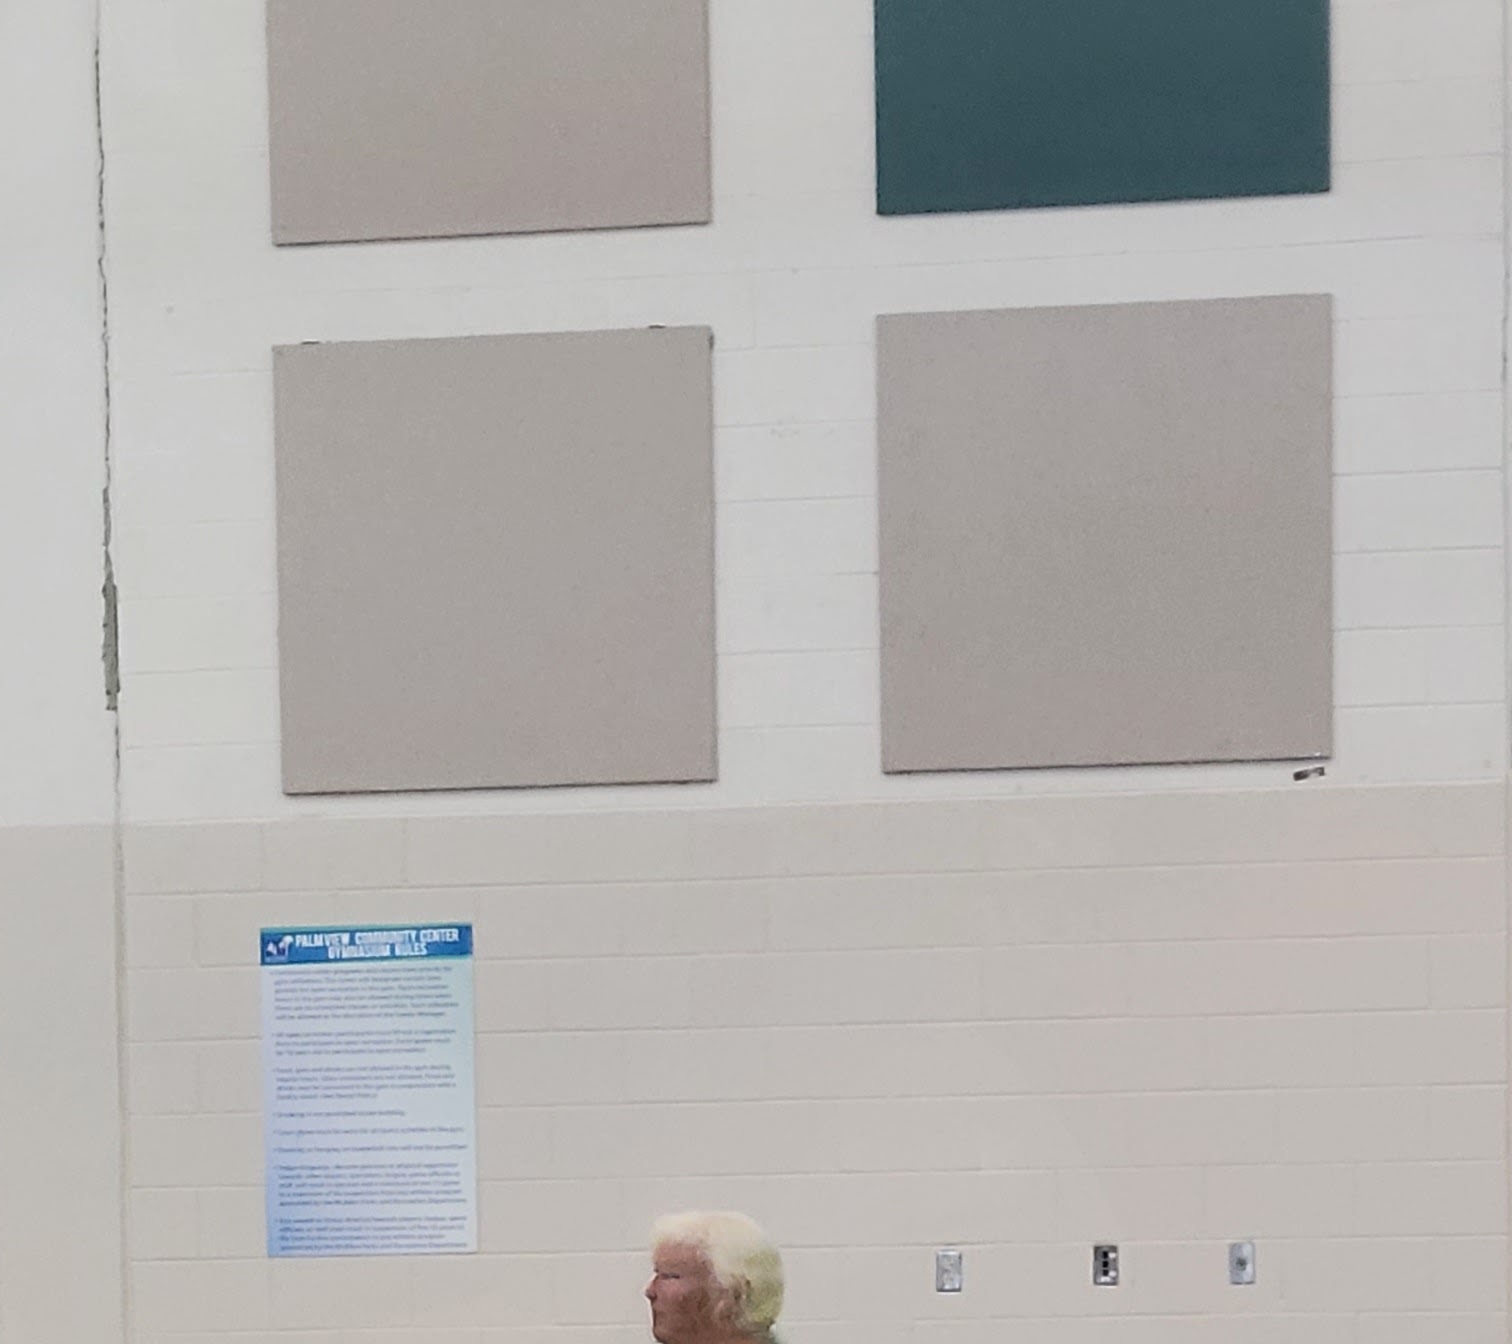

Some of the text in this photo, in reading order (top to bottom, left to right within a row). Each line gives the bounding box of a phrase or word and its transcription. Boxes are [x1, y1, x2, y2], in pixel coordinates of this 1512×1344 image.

[355, 930, 415, 944] COMMUNITY
[420, 929, 459, 942] CENTER
[328, 942, 427, 958] GYMNASIUM RULES
